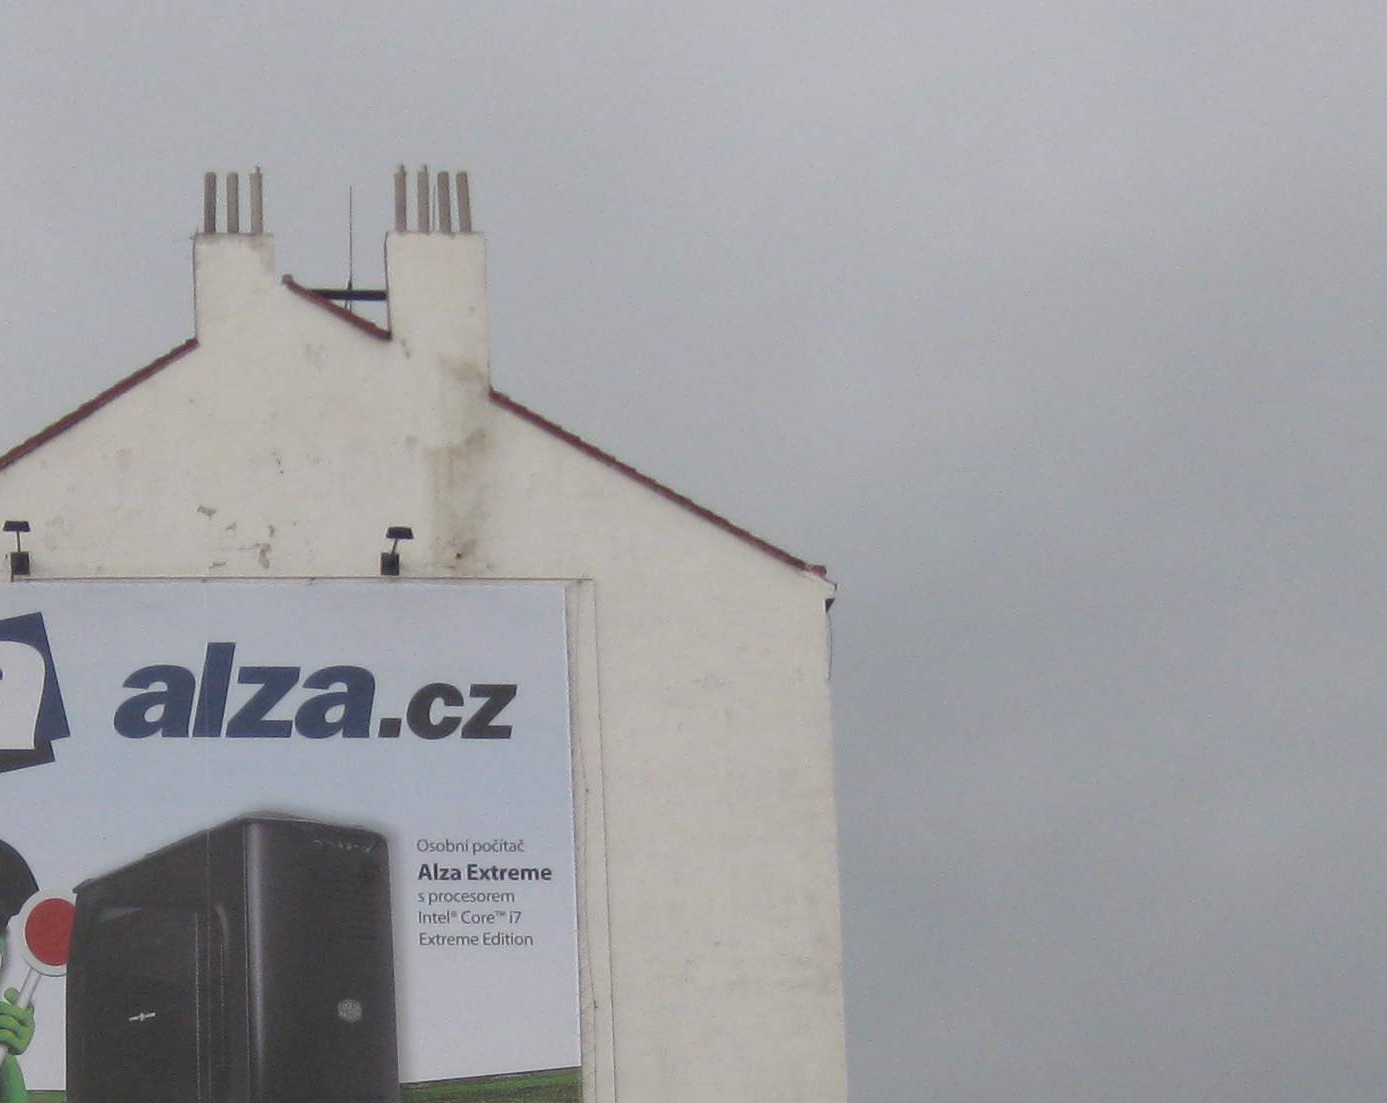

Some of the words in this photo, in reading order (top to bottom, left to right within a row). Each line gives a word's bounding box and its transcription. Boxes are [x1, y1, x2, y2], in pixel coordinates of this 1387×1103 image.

[114, 641, 518, 740] alza.cz
[416, 838, 469, 853] Osobní
[472, 839, 525, 856] počítač
[417, 863, 462, 881] Alza
[467, 863, 553, 881] Extreme
[417, 893, 425, 903] s
[428, 892, 516, 906] procesorem
[509, 910, 522, 925] i7
[419, 932, 480, 946] Extreme
[483, 931, 534, 946] Edition
